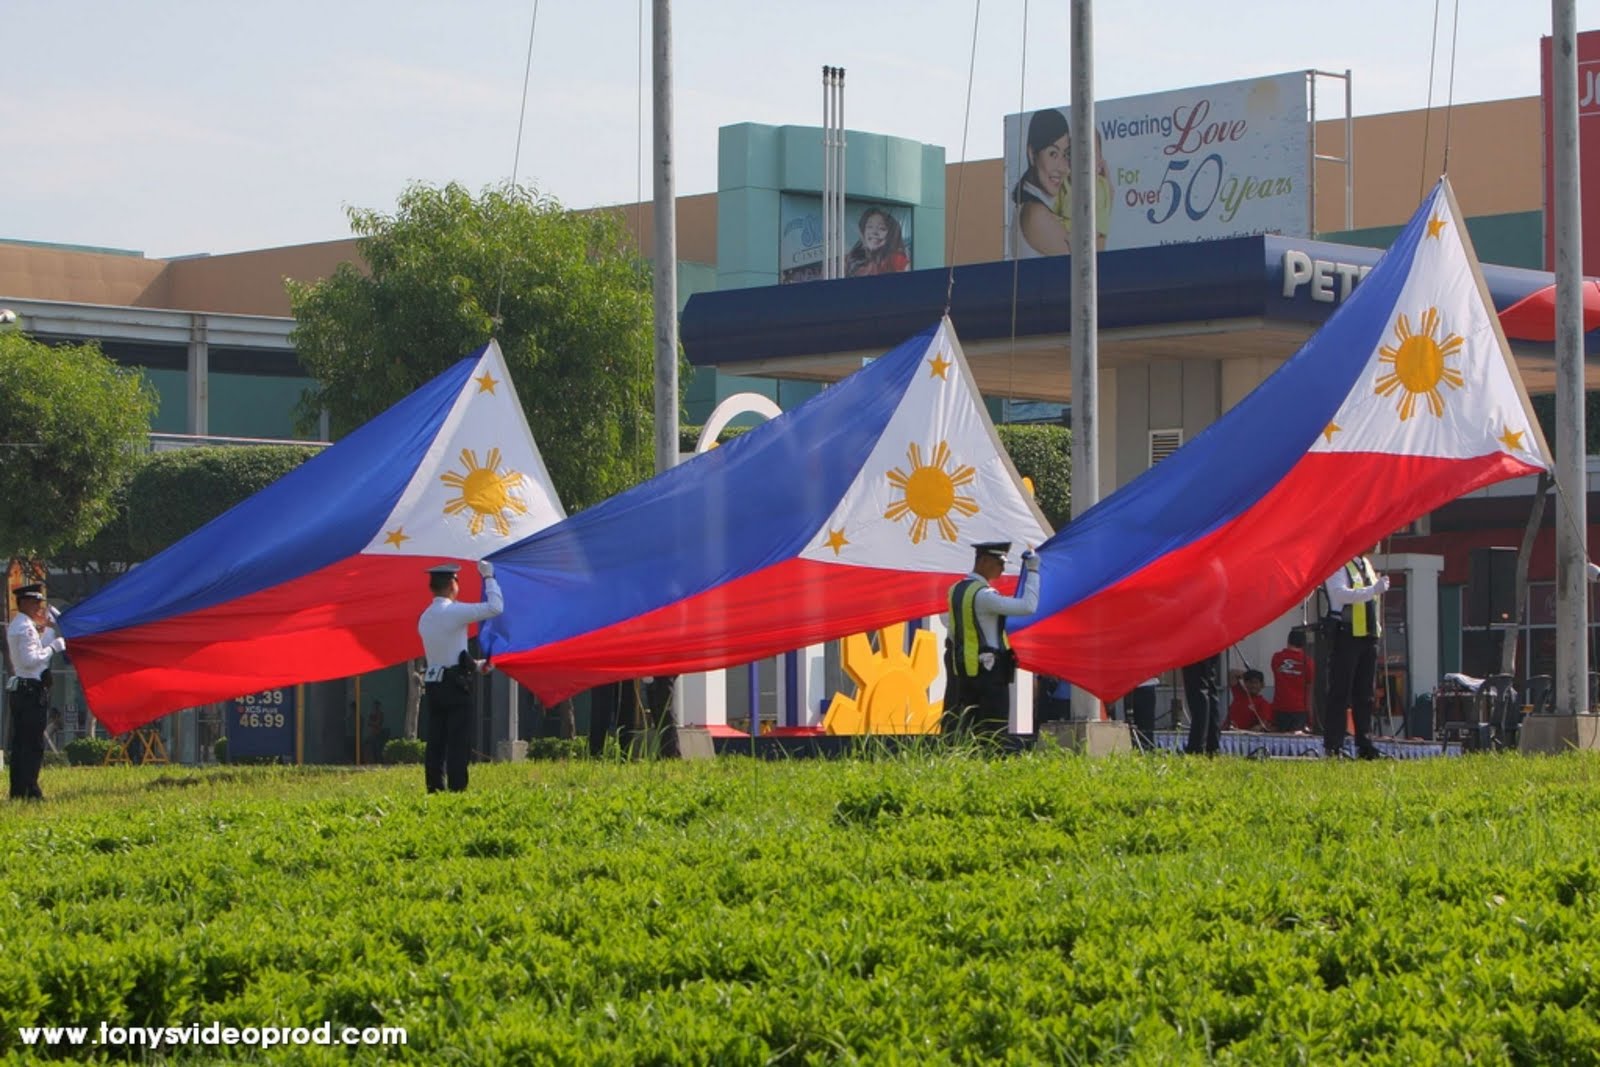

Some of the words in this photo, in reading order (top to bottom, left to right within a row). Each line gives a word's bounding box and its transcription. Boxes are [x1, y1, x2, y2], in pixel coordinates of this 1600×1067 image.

[1101, 114, 1172, 140] Wearing
[1164, 100, 1247, 155] Love
[1117, 168, 1140, 186] For
[1125, 189, 1161, 207] Over
[1147, 153, 1223, 224] 50
[1219, 175, 1293, 223] Years
[245, 705, 261, 713] XCS
[240, 714, 284, 727] 46.99
